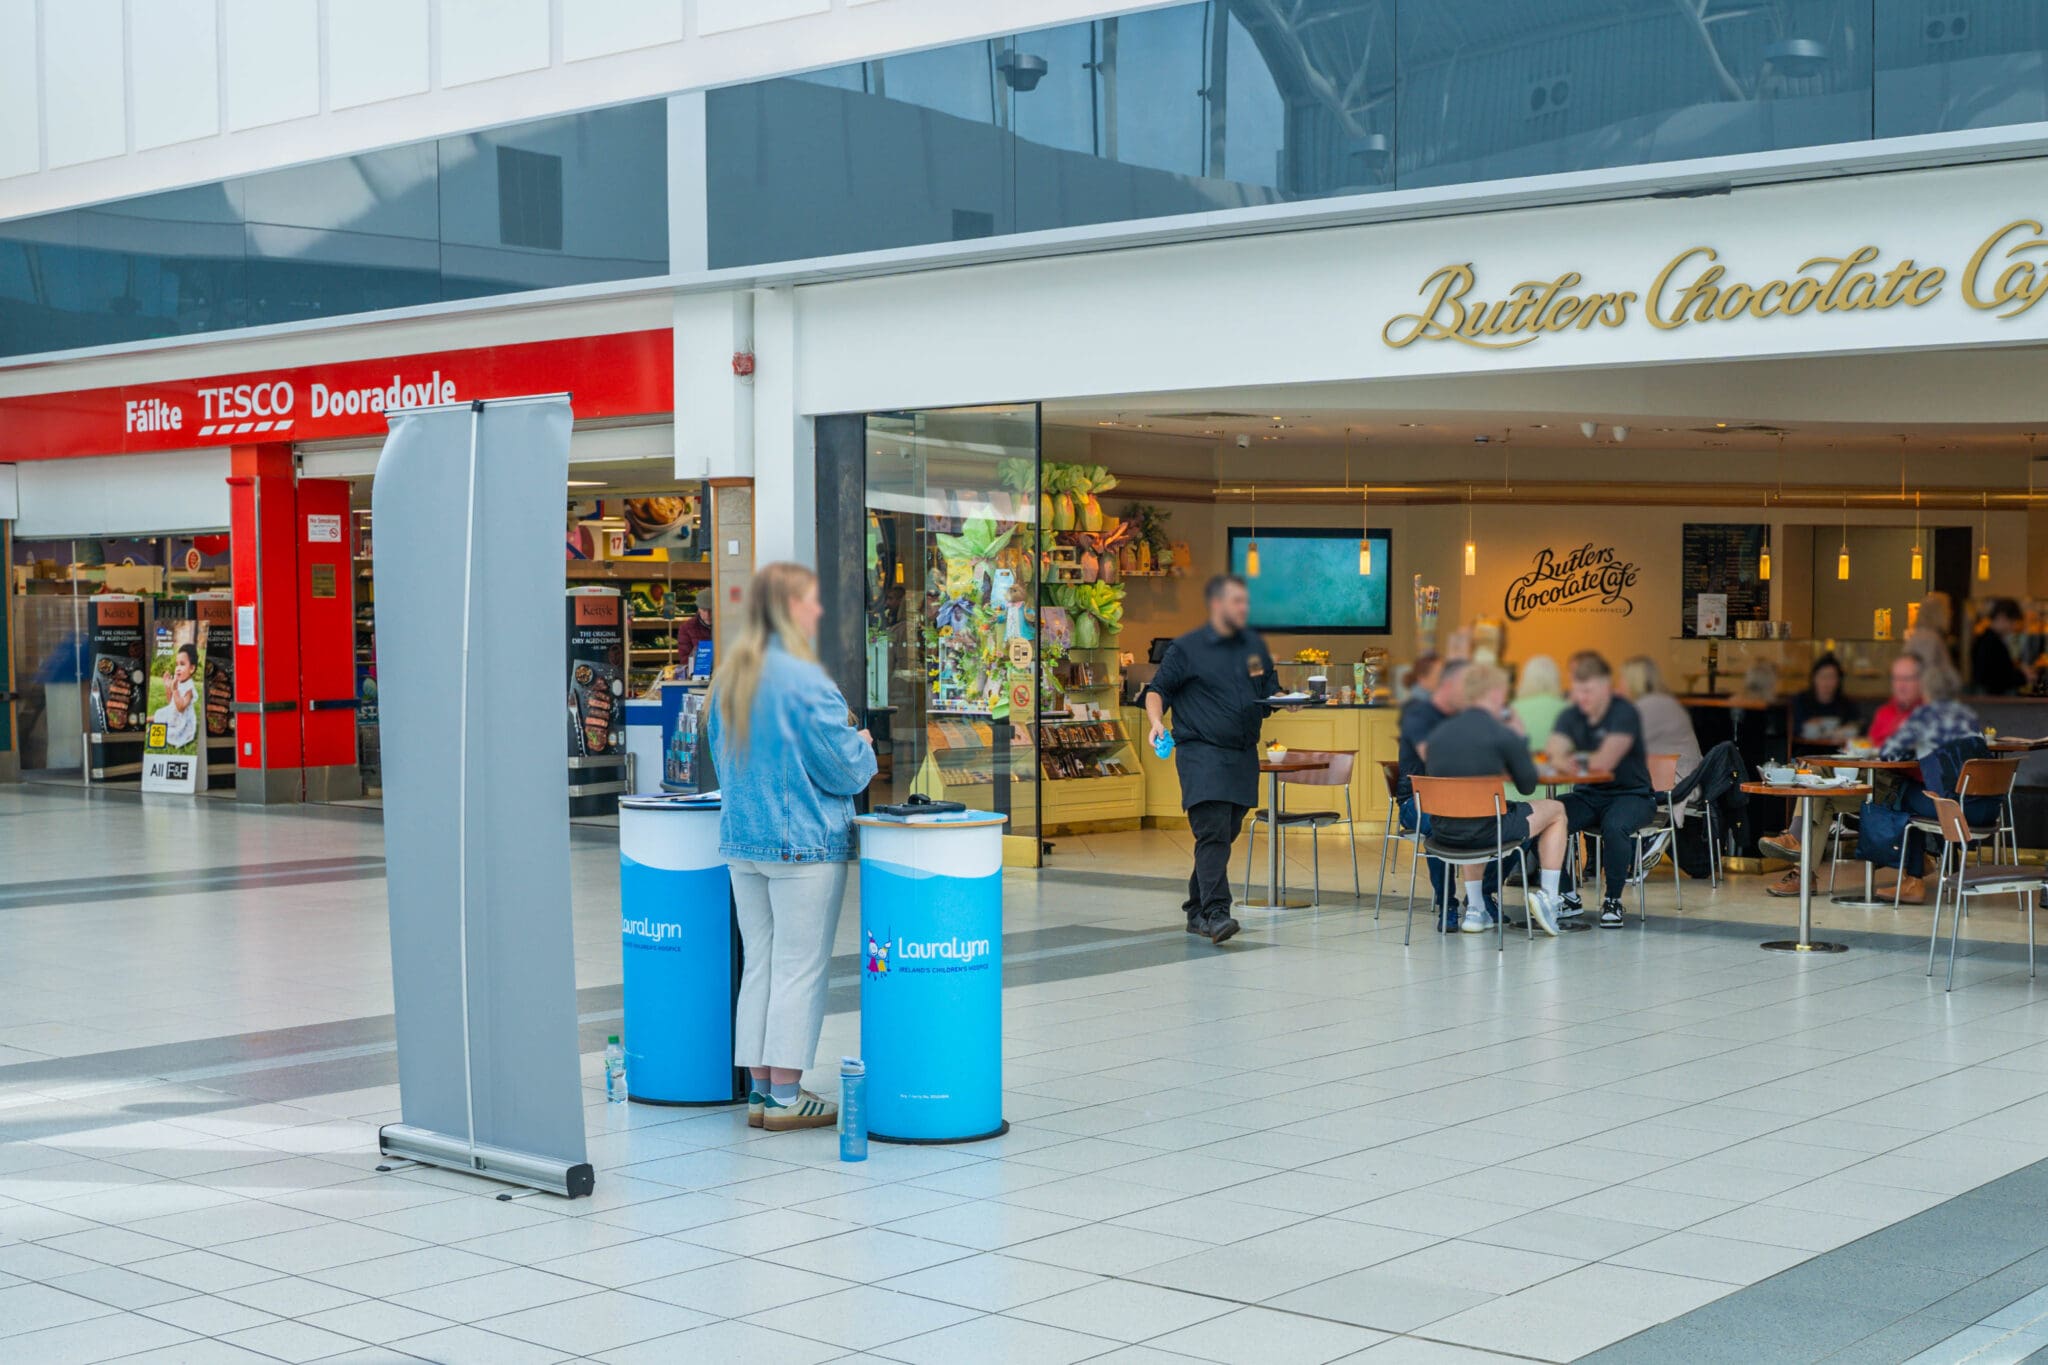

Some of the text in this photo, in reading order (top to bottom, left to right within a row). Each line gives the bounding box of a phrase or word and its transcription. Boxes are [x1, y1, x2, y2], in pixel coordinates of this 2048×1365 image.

[1382, 262, 1636, 349] Butlers
[1645, 245, 1946, 330] Chocolate
[125, 398, 182, 433] Fáilte
[198, 381, 294, 420] TESCO
[611, 536, 622, 550] 17
[1522, 542, 1615, 587] Butlers
[1504, 569, 1600, 621] Chocolate
[1596, 561, 1641, 617] Café
[150, 763, 188, 778] All F&F
[898, 936, 990, 962] LauraLynn
